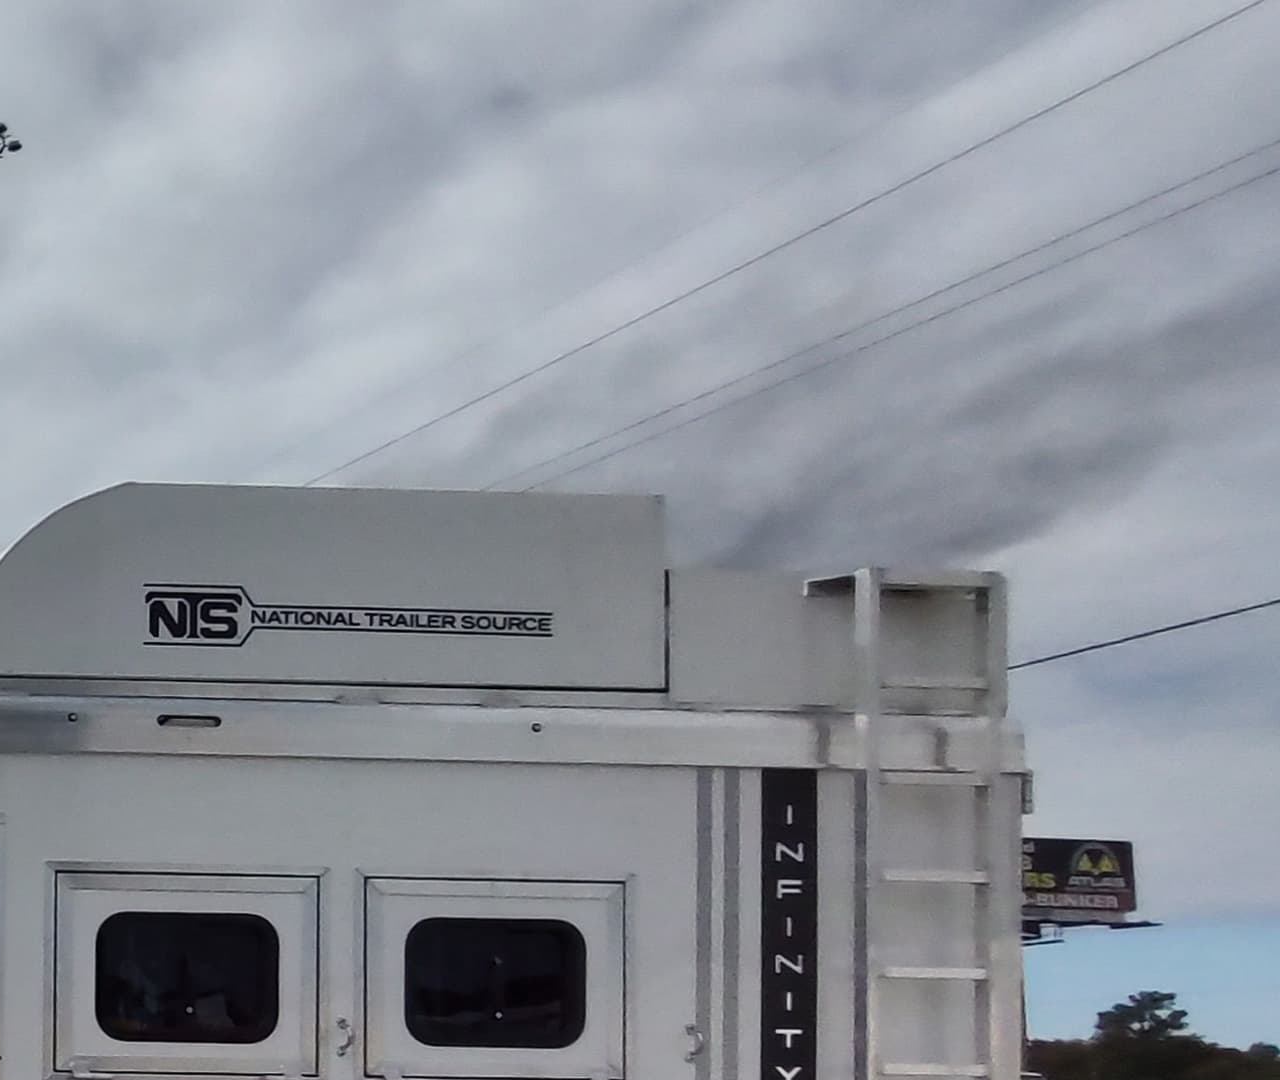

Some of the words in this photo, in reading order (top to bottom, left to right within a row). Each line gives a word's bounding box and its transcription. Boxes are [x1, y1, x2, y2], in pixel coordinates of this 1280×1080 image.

[145, 591, 242, 639] NTS
[250, 609, 361, 627] NATIONAL
[364, 611, 457, 630] TRAILER
[461, 613, 552, 633] SOURCE
